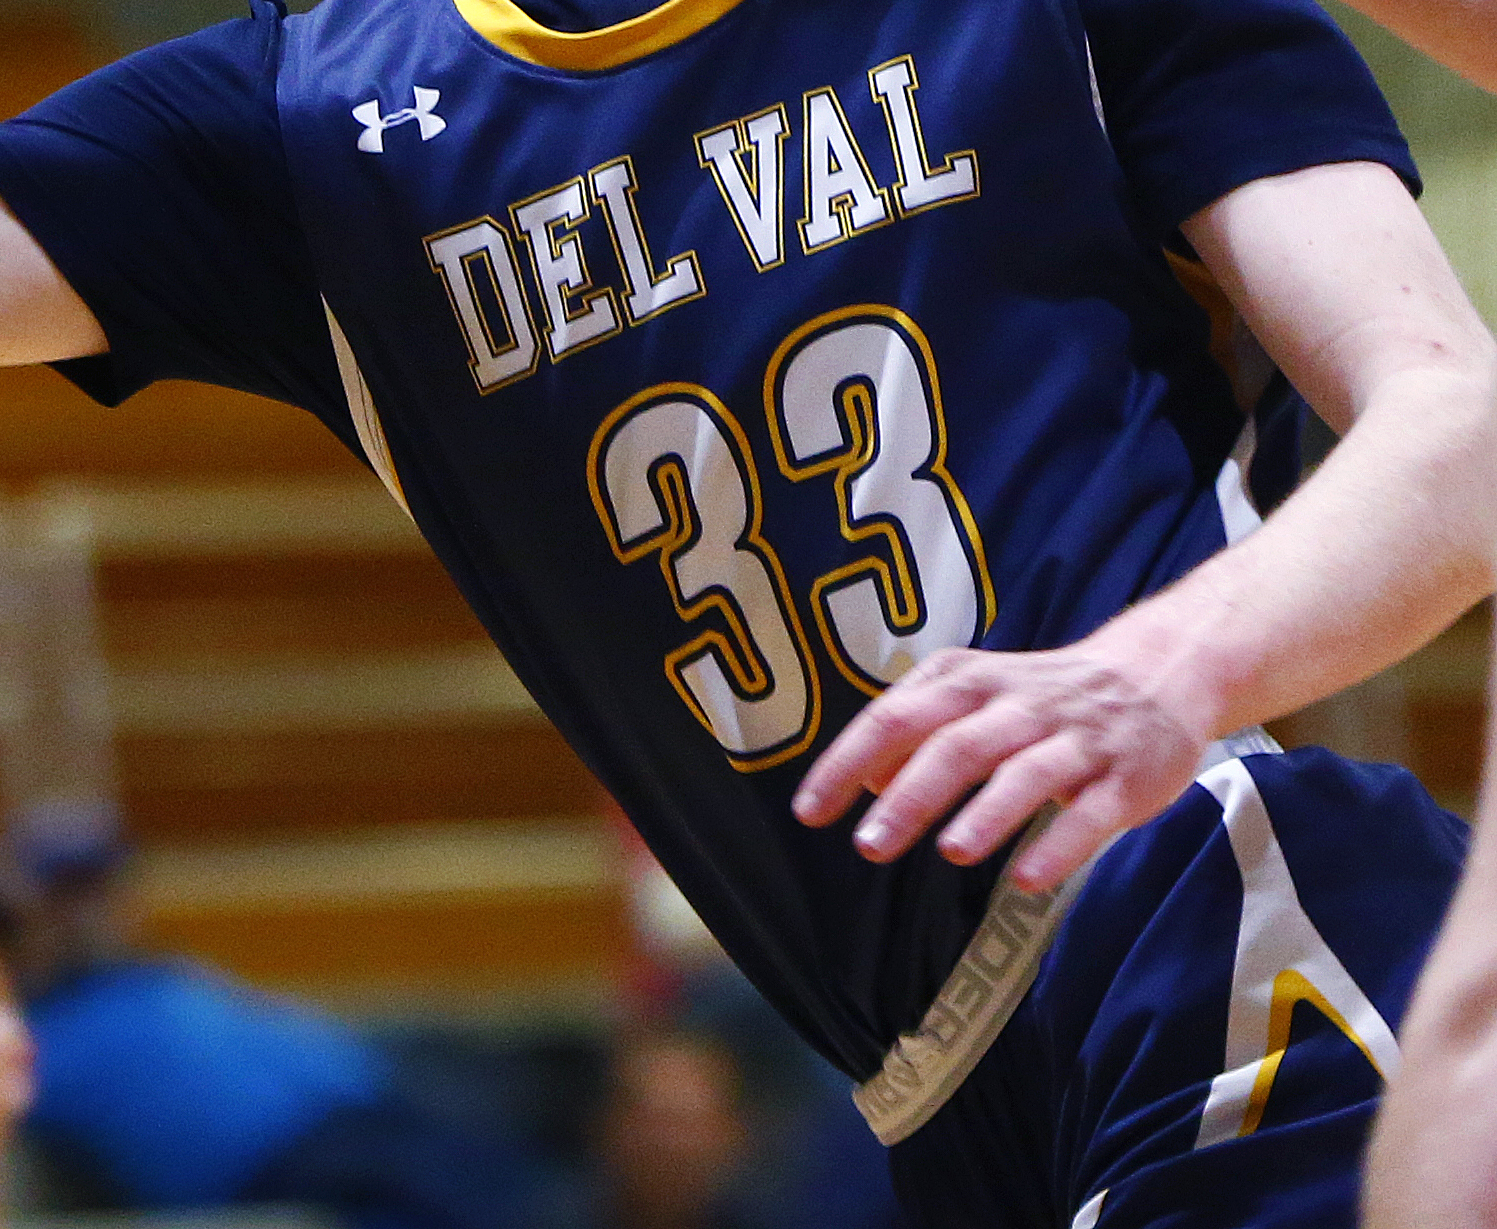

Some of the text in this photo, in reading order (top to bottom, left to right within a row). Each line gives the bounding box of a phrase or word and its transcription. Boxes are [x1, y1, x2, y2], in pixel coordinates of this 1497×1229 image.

[423, 55, 980, 395] DEL VAL
[587, 304, 996, 773] 33
[919, 887, 1059, 1047] NDER
